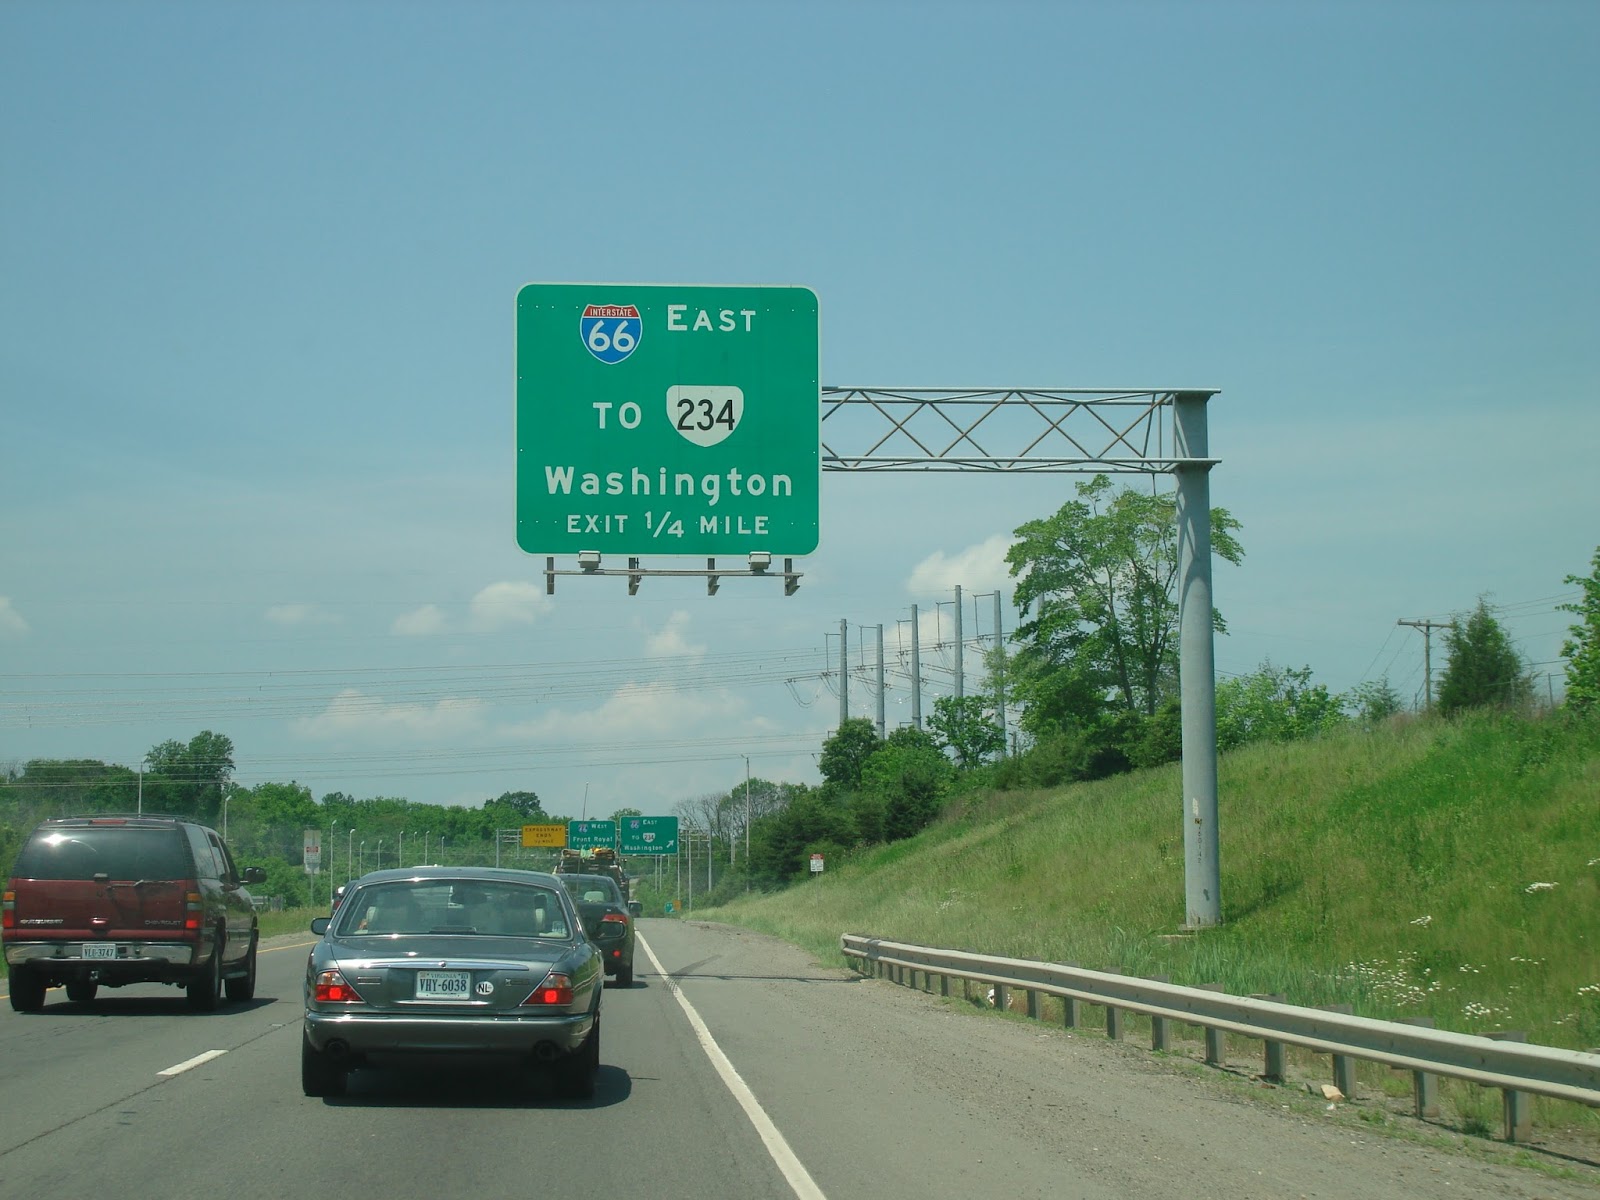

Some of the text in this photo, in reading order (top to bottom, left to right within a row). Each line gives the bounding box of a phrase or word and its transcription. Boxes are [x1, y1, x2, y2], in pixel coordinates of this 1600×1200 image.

[590, 308, 632, 317] INTERSTATE
[667, 304, 757, 332] EAST
[588, 320, 635, 352] 66
[593, 399, 736, 431] TO 234
[545, 465, 792, 506] Washington
[567, 511, 769, 538] EXIT 1/4 MILE
[420, 979, 467, 992] VHY-6038
[478, 983, 490, 994] NL
